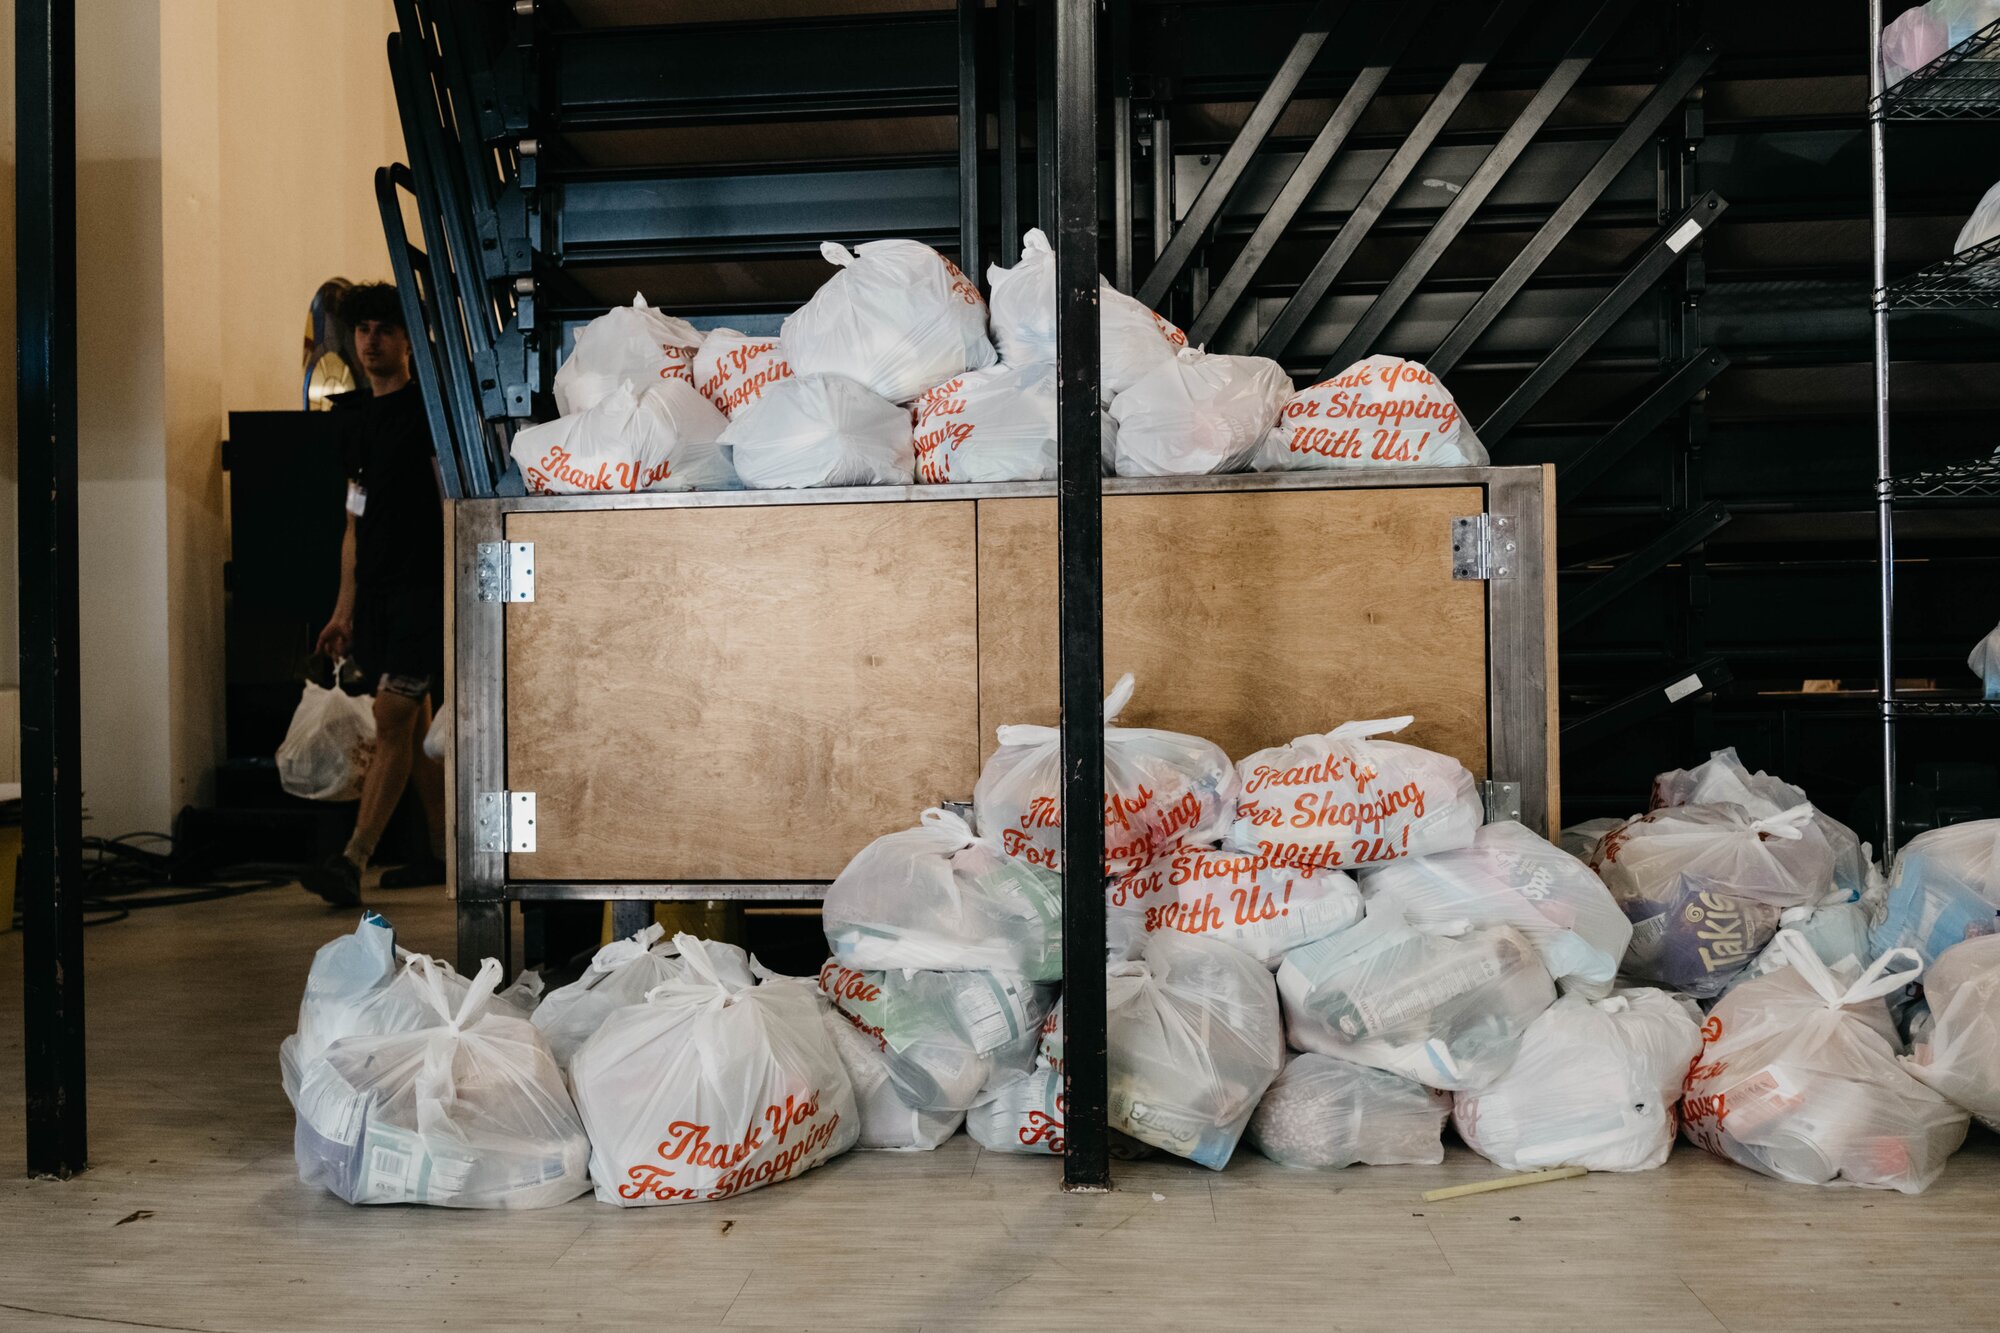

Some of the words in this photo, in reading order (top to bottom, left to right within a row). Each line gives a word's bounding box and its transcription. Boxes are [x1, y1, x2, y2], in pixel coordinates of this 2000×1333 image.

[727, 344, 775, 375] You
[1378, 362, 1435, 393] You
[714, 359, 797, 416] Shoppin
[1282, 400, 1320, 418] or
[1326, 391, 1460, 433] Shopping
[1290, 427, 1362, 459] With
[1370, 431, 1431, 462] Us!
[541, 445, 613, 491] Thank
[616, 460, 672, 492] You
[1290, 782, 1425, 832] Shopping
[1002, 828, 1059, 869] For
[1257, 840, 1344, 868] With
[1351, 824, 1410, 864] Us!
[1112, 871, 1163, 907] For
[1230, 879, 1294, 926] Us!
[657, 1117, 764, 1169] Thank
[765, 1089, 820, 1145] You
[1018, 1110, 1064, 1153] Fo
[618, 1164, 699, 1200] For
[707, 1110, 841, 1200] Shopping
